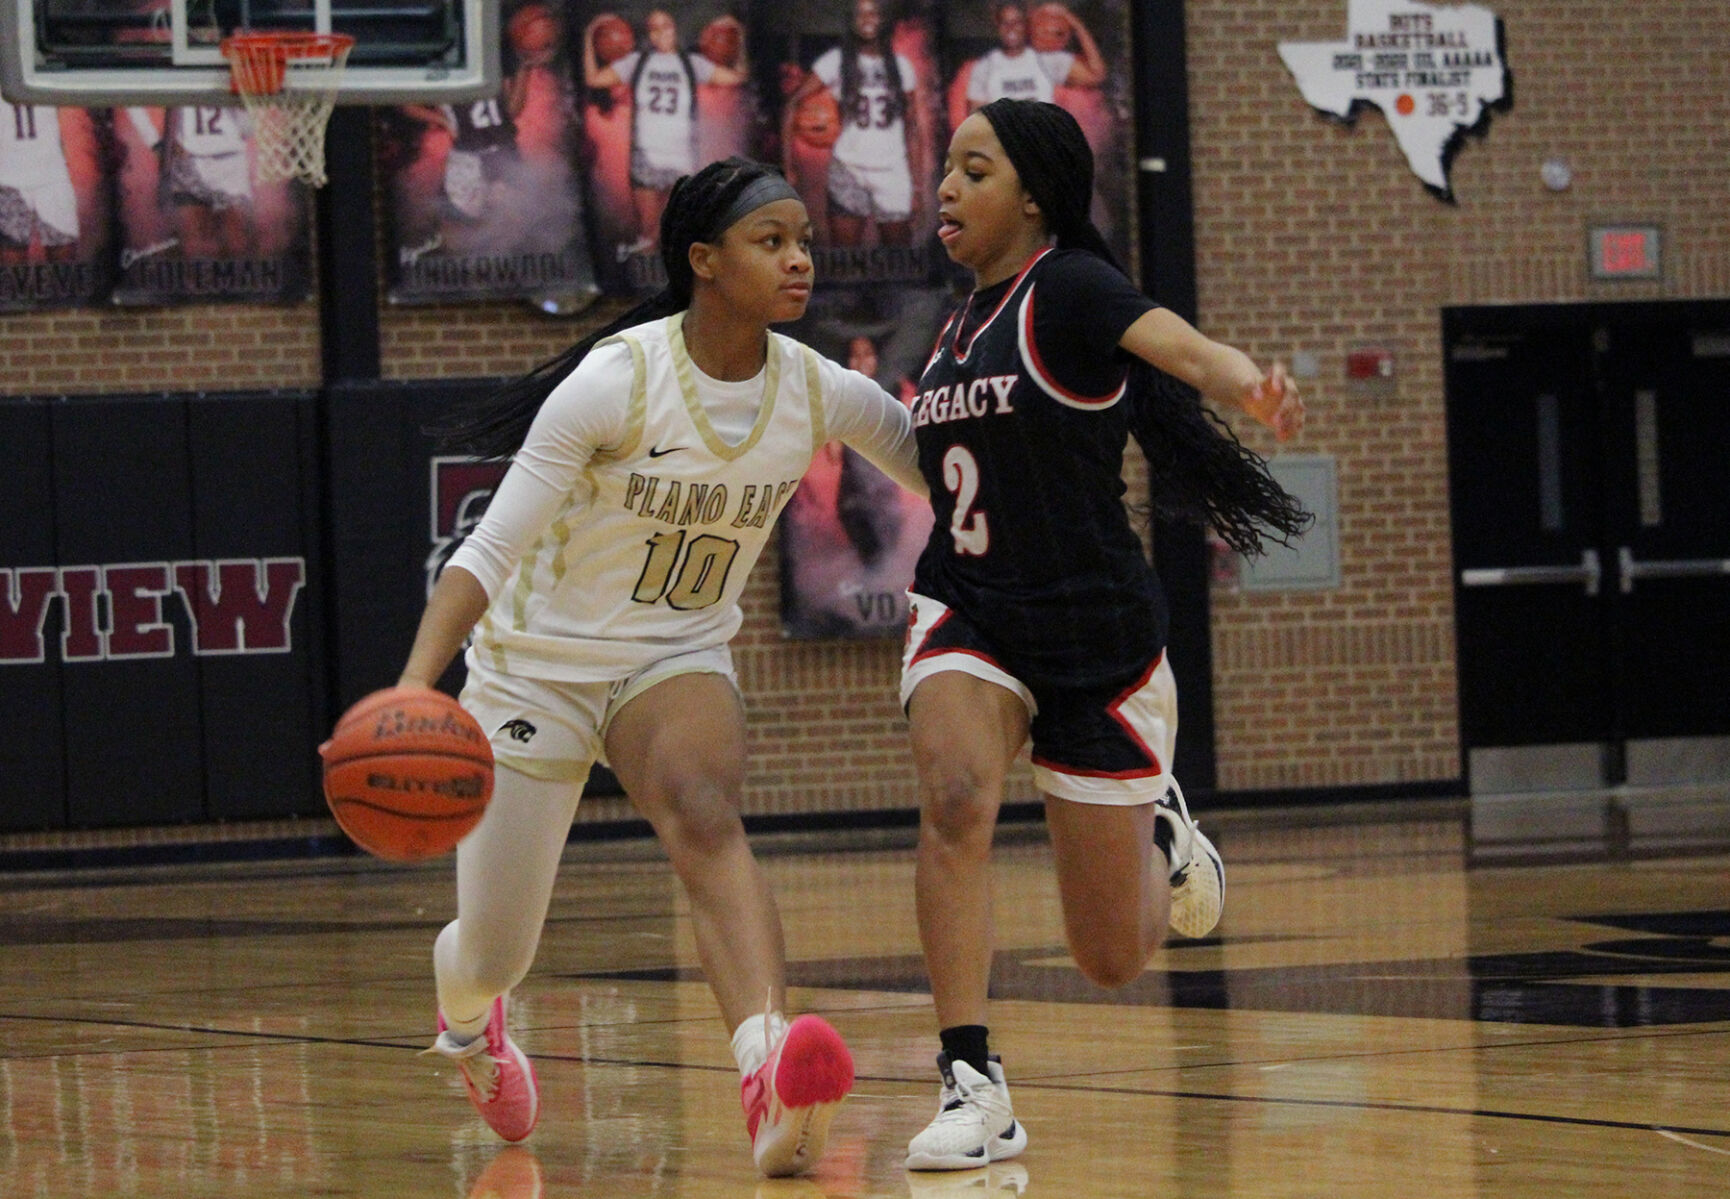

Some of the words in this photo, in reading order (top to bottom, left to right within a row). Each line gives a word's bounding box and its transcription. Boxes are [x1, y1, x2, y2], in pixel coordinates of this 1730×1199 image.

[1355, 33, 1469, 48] BASKETBALL
[649, 85, 679, 115] 23
[1356, 72, 1399, 88] STATE
[1405, 71, 1471, 87] FINALIST
[813, 247, 924, 279] OHNSON
[909, 374, 1019, 428] LEGACY
[623, 472, 728, 526] PLANO
[942, 444, 989, 557] 2
[630, 529, 741, 611] 10
[0, 556, 306, 664] VIEW
